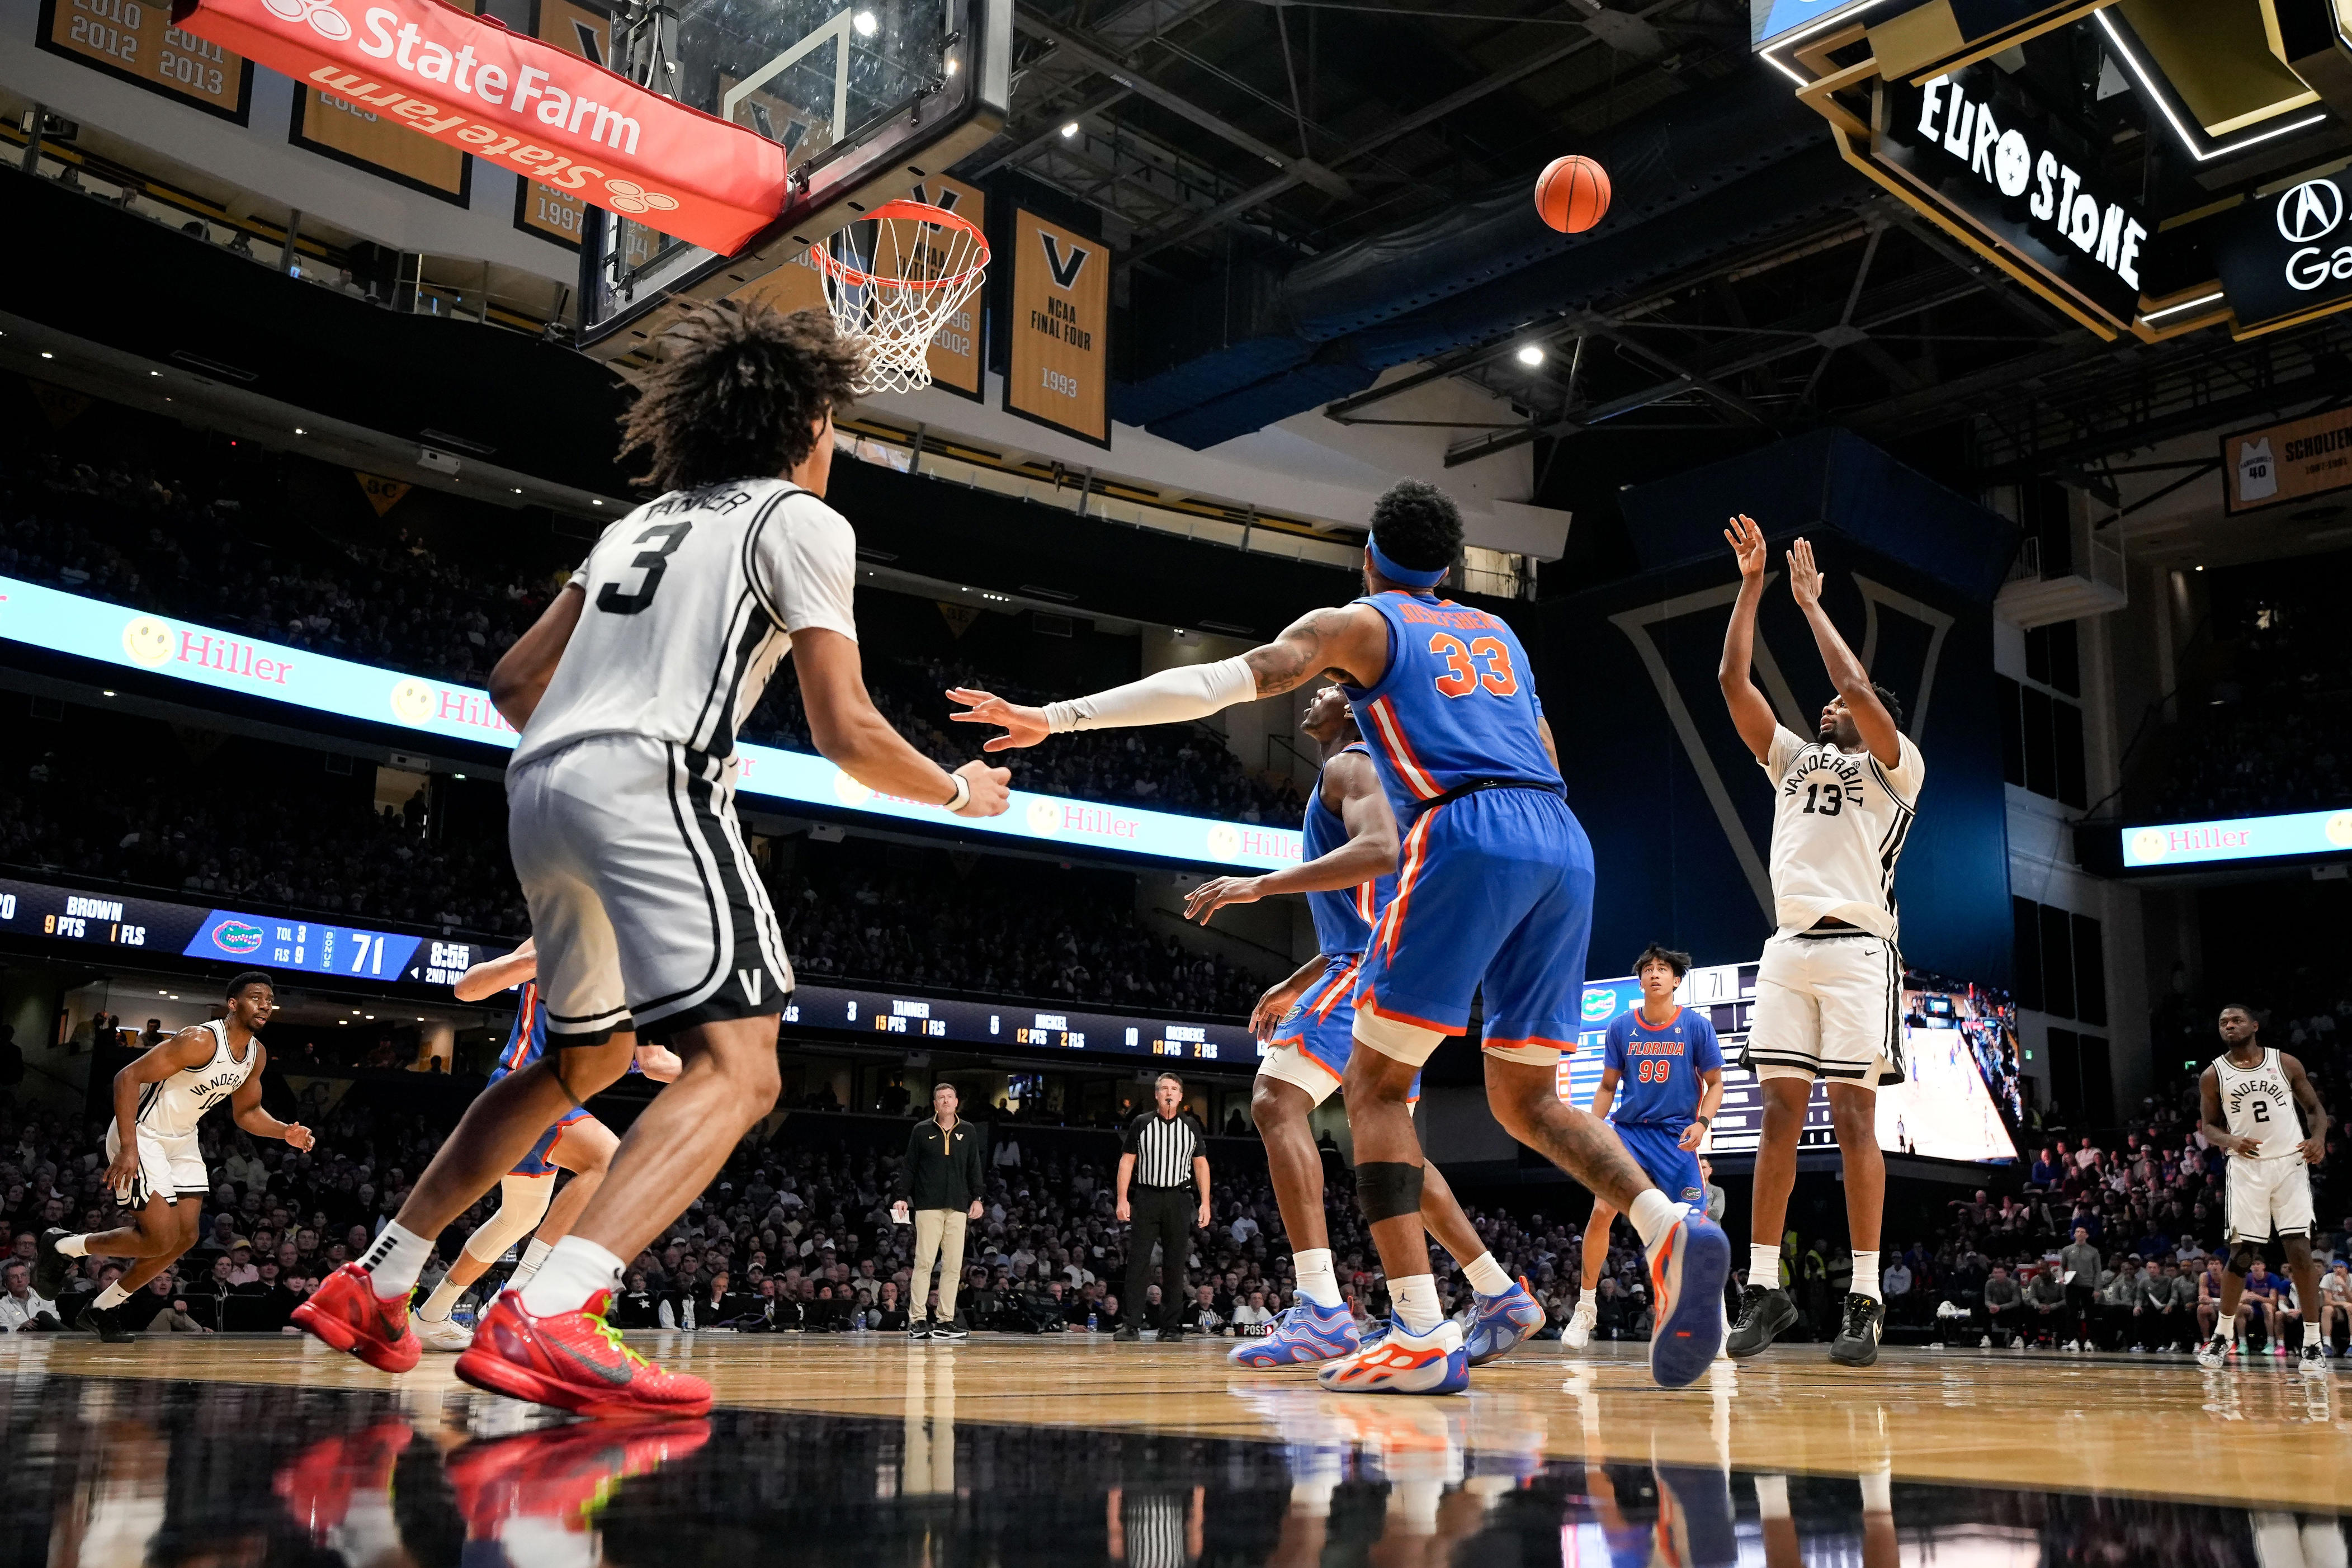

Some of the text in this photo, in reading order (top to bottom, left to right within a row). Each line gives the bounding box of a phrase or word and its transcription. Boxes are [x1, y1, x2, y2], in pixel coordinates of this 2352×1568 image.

[70, 15, 138, 63] 2012
[159, 50, 223, 95] 2013
[1047, 295, 1077, 325] NCAA
[1031, 311, 1092, 352] FINAL FOUR
[1041, 367, 1078, 399] 1993
[2249, 464, 2267, 479] 40
[595, 521, 692, 616] 3
[177, 630, 294, 686] Hiller
[1428, 632, 1519, 699] 33
[1785, 753, 1864, 807] VANDERBILT
[1803, 783, 1843, 816] 13
[1063, 806, 1140, 838] Hiller
[2169, 828, 2250, 851] Hiller
[67, 896, 123, 922] BROWN
[44, 914, 146, 946] 9 PTS 1 FLS
[276, 925, 306, 943] TOL 3
[273, 946, 304, 964] FLS 9
[323, 931, 334, 968] BONUS
[351, 933, 384, 975] 71
[430, 942, 470, 970] 8:55
[425, 967, 446, 984] 2ND
[738, 968, 761, 1006] V
[1709, 973, 1723, 998] 71
[847, 1001, 857, 1021] 3
[892, 1000, 929, 1018] TANNER
[875, 1015, 946, 1037] 15 PTS 1 FLS
[990, 1015, 1000, 1035] 5
[1035, 1013, 1068, 1032] NICKEL
[1017, 1028, 1084, 1049] 12 PTS 2 FLS
[1125, 1027, 1139, 1047] 10
[1153, 1040, 1217, 1059] 13 PTS 2 FLS
[1626, 1042, 1684, 1056] FLORIDA
[1638, 1059, 1670, 1083] 99
[2230, 1080, 2287, 1113] VANDERBILT
[2252, 1101, 2270, 1123] 2
